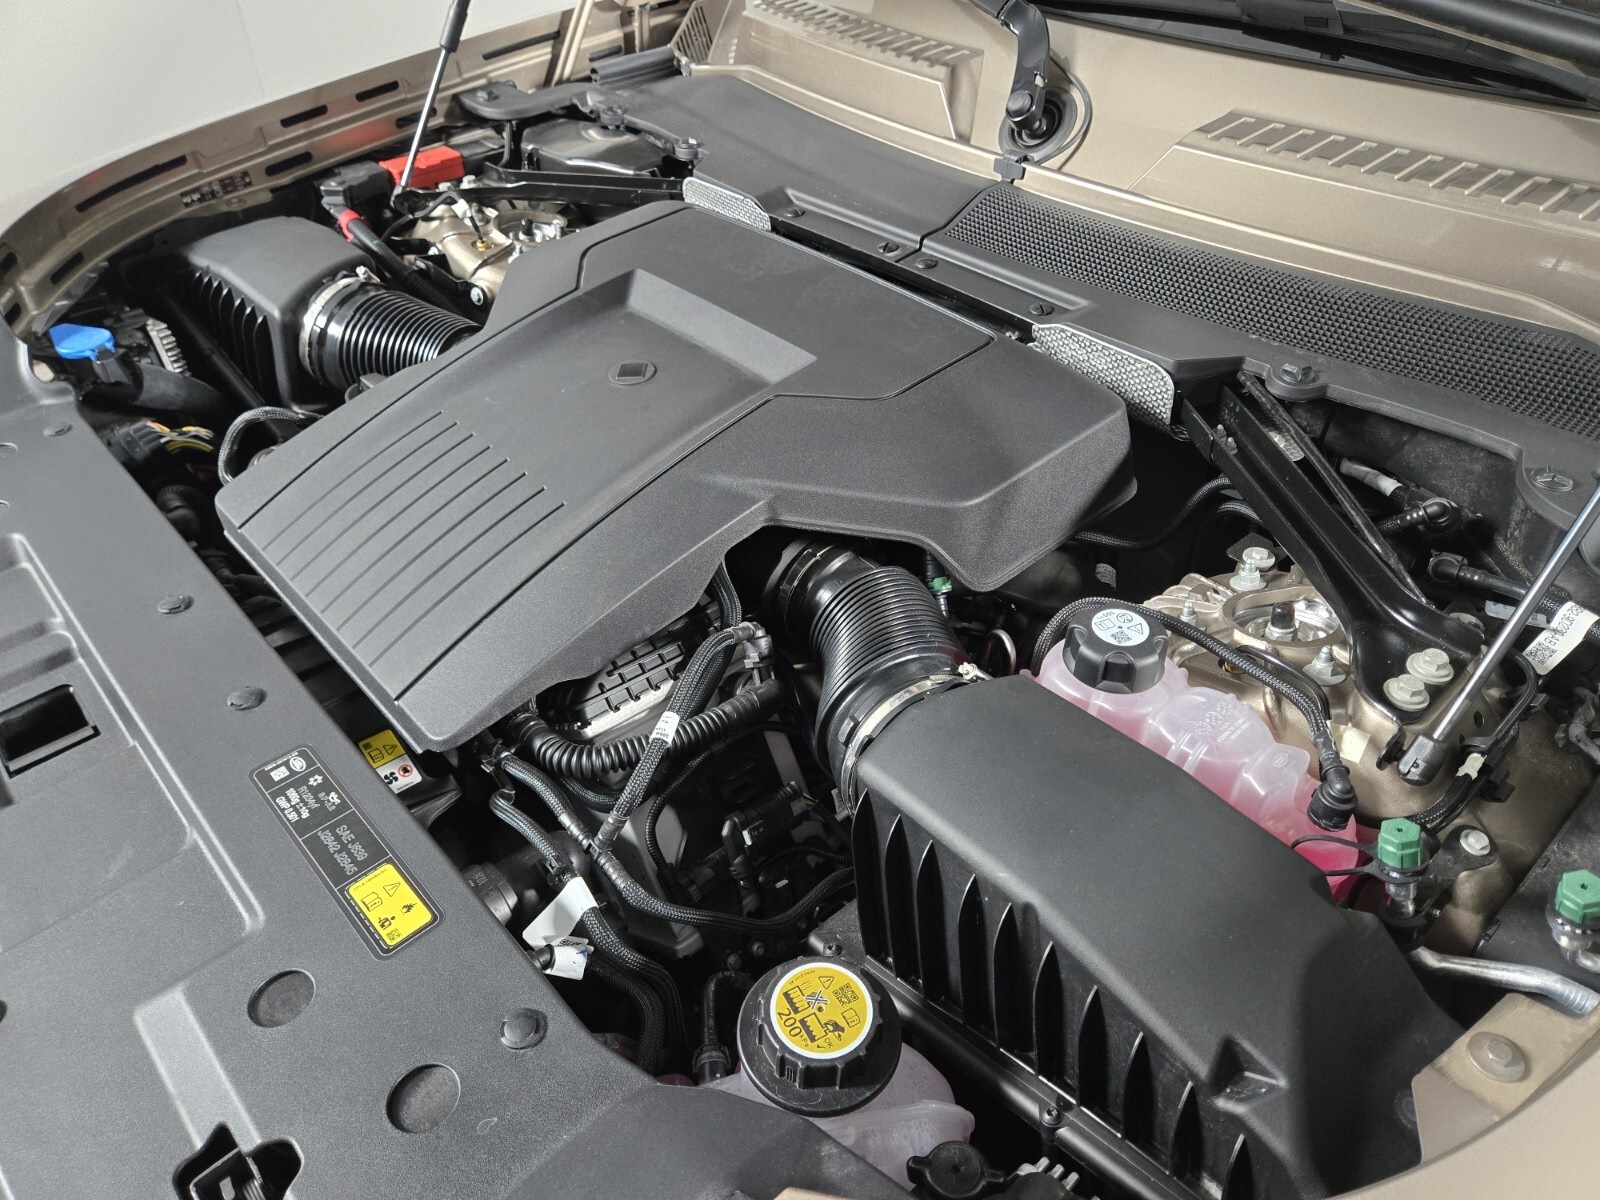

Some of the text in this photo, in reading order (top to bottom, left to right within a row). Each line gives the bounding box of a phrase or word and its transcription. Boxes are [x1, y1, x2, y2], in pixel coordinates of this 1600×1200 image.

[317, 830, 358, 876] J2842 J2845
[336, 825, 368, 861] SAE J639
[824, 1038, 834, 1049] OK
